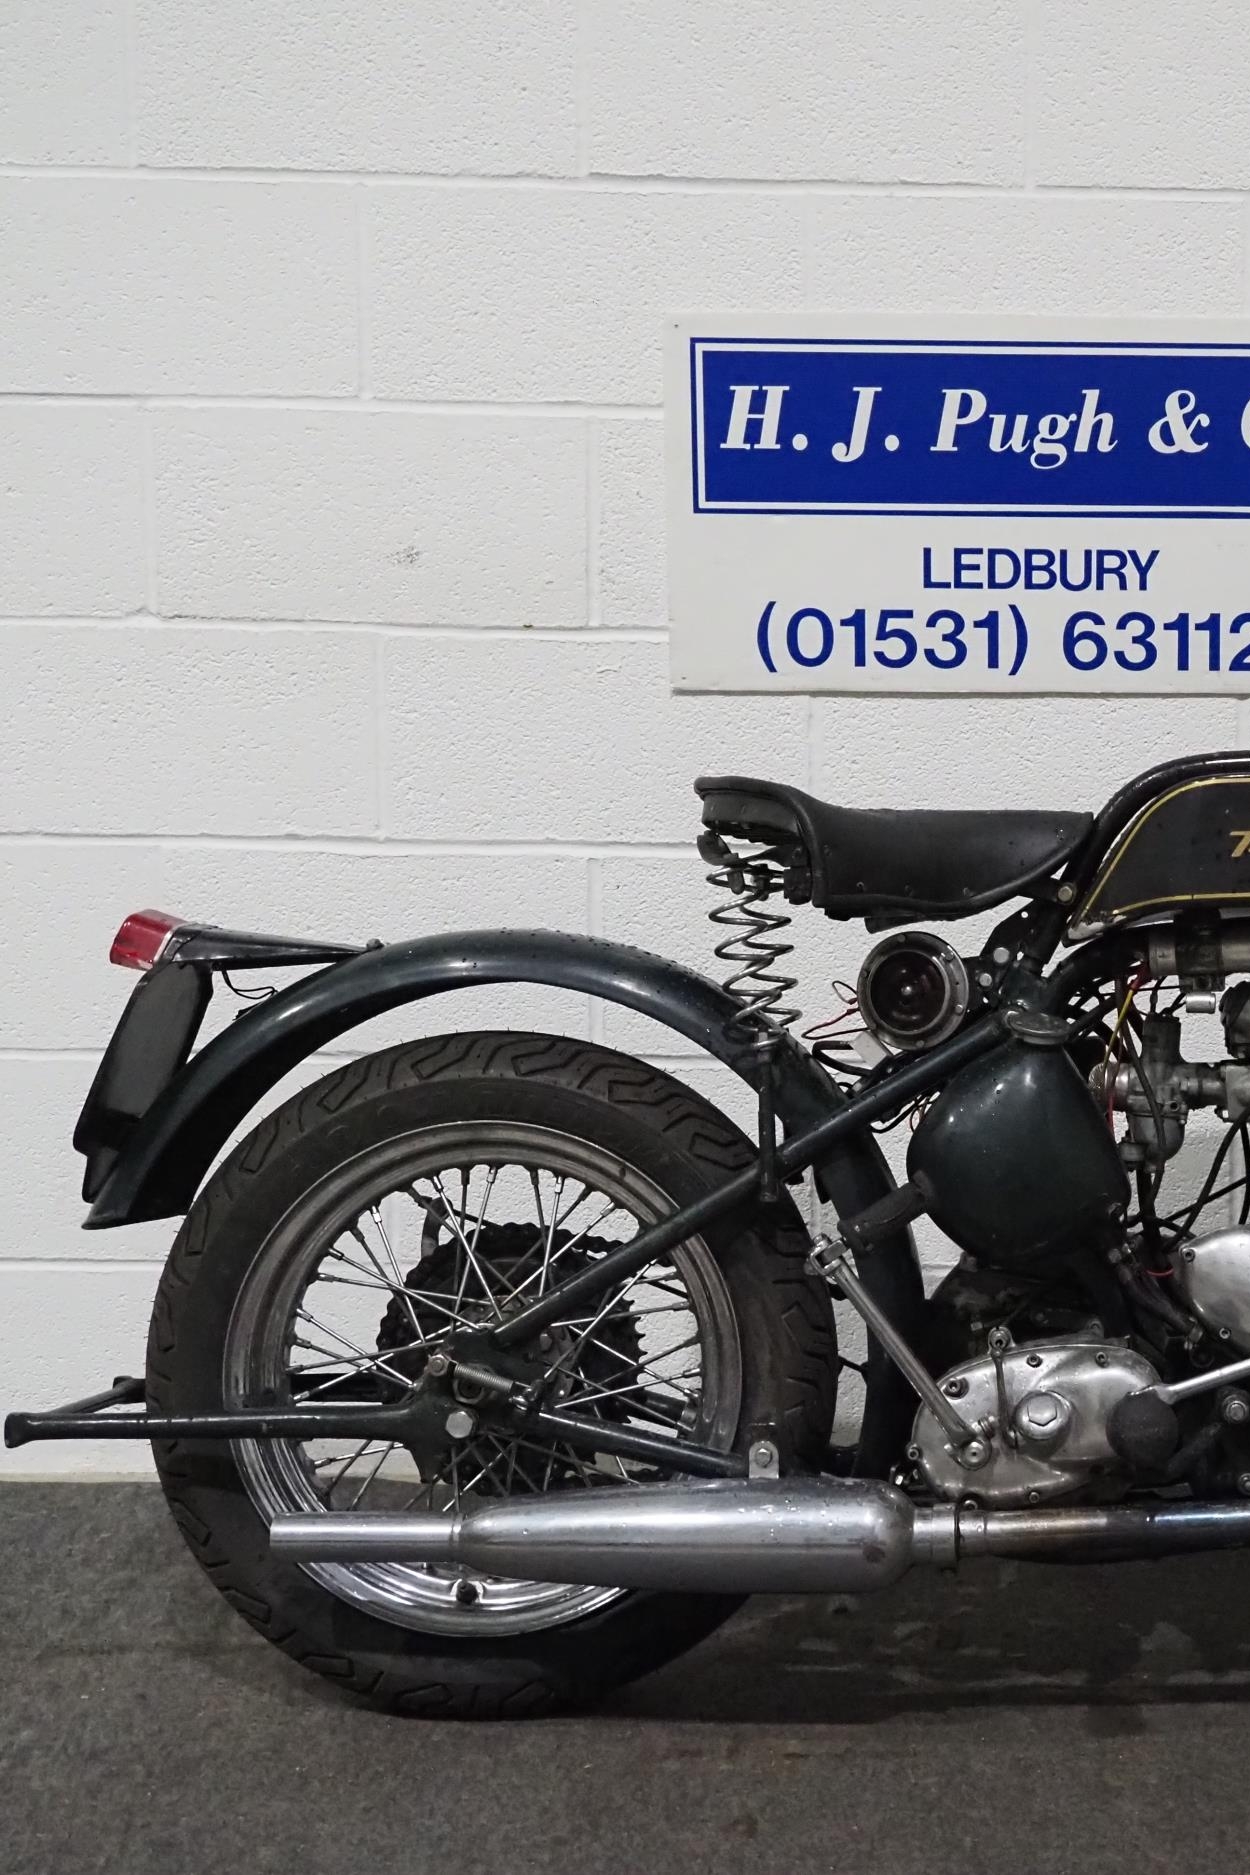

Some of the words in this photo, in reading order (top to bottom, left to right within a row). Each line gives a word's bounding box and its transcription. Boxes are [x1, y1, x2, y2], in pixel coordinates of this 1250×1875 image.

[720, 385, 808, 451] H.
[832, 386, 899, 462] J.
[930, 388, 1117, 469] Pugh
[1149, 389, 1210, 454] &
[923, 547, 1160, 591] LEDBURY
[756, 600, 1029, 676] (01531)
